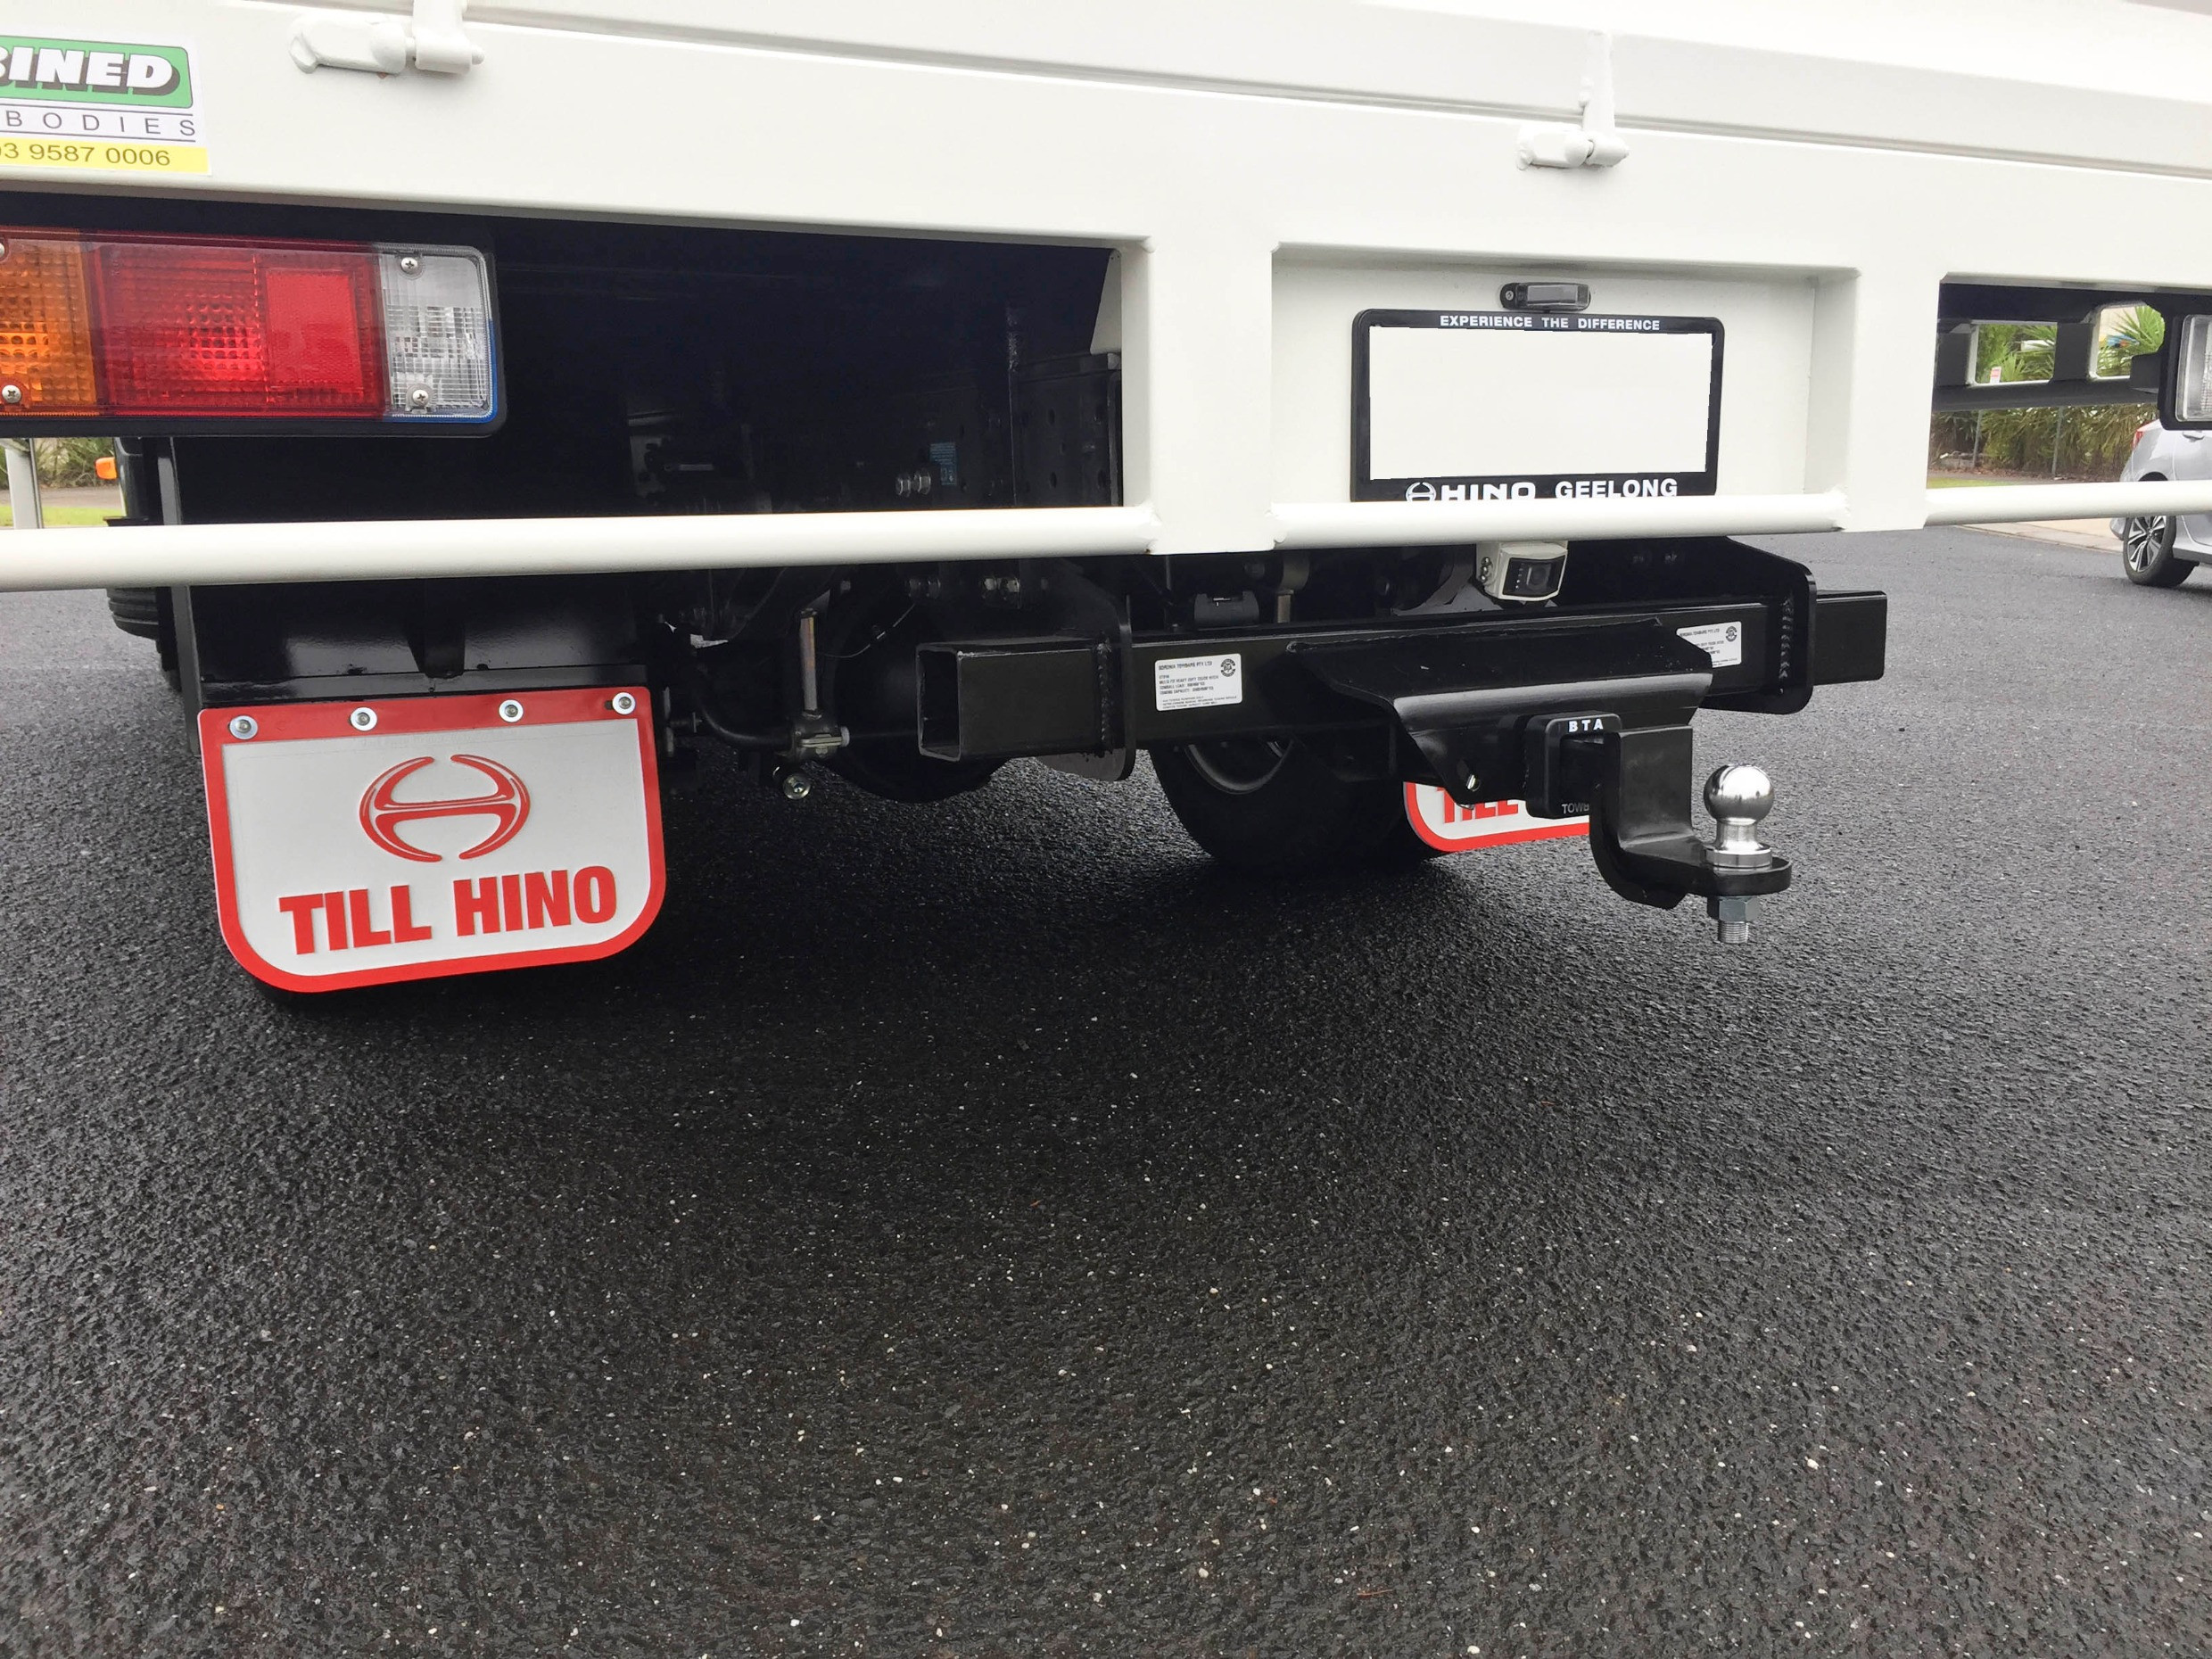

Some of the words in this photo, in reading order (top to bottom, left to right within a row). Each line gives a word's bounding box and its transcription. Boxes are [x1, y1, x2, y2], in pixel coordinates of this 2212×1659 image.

[0, 46, 180, 96] INED
[6, 111, 195, 136] BODIES
[0, 143, 19, 159] 3
[29, 144, 95, 162] 9587
[105, 148, 170, 166] 0006
[1440, 315, 1532, 328] EXPERIENCE
[1541, 317, 1569, 328] THE
[1578, 318, 1660, 331] DIFFERENCE
[1441, 482, 1536, 501] HINO
[1555, 478, 1678, 499] GEELONG
[1568, 718, 1604, 733] BTA
[278, 886, 433, 955] TILL
[453, 865, 617, 937] HINO
